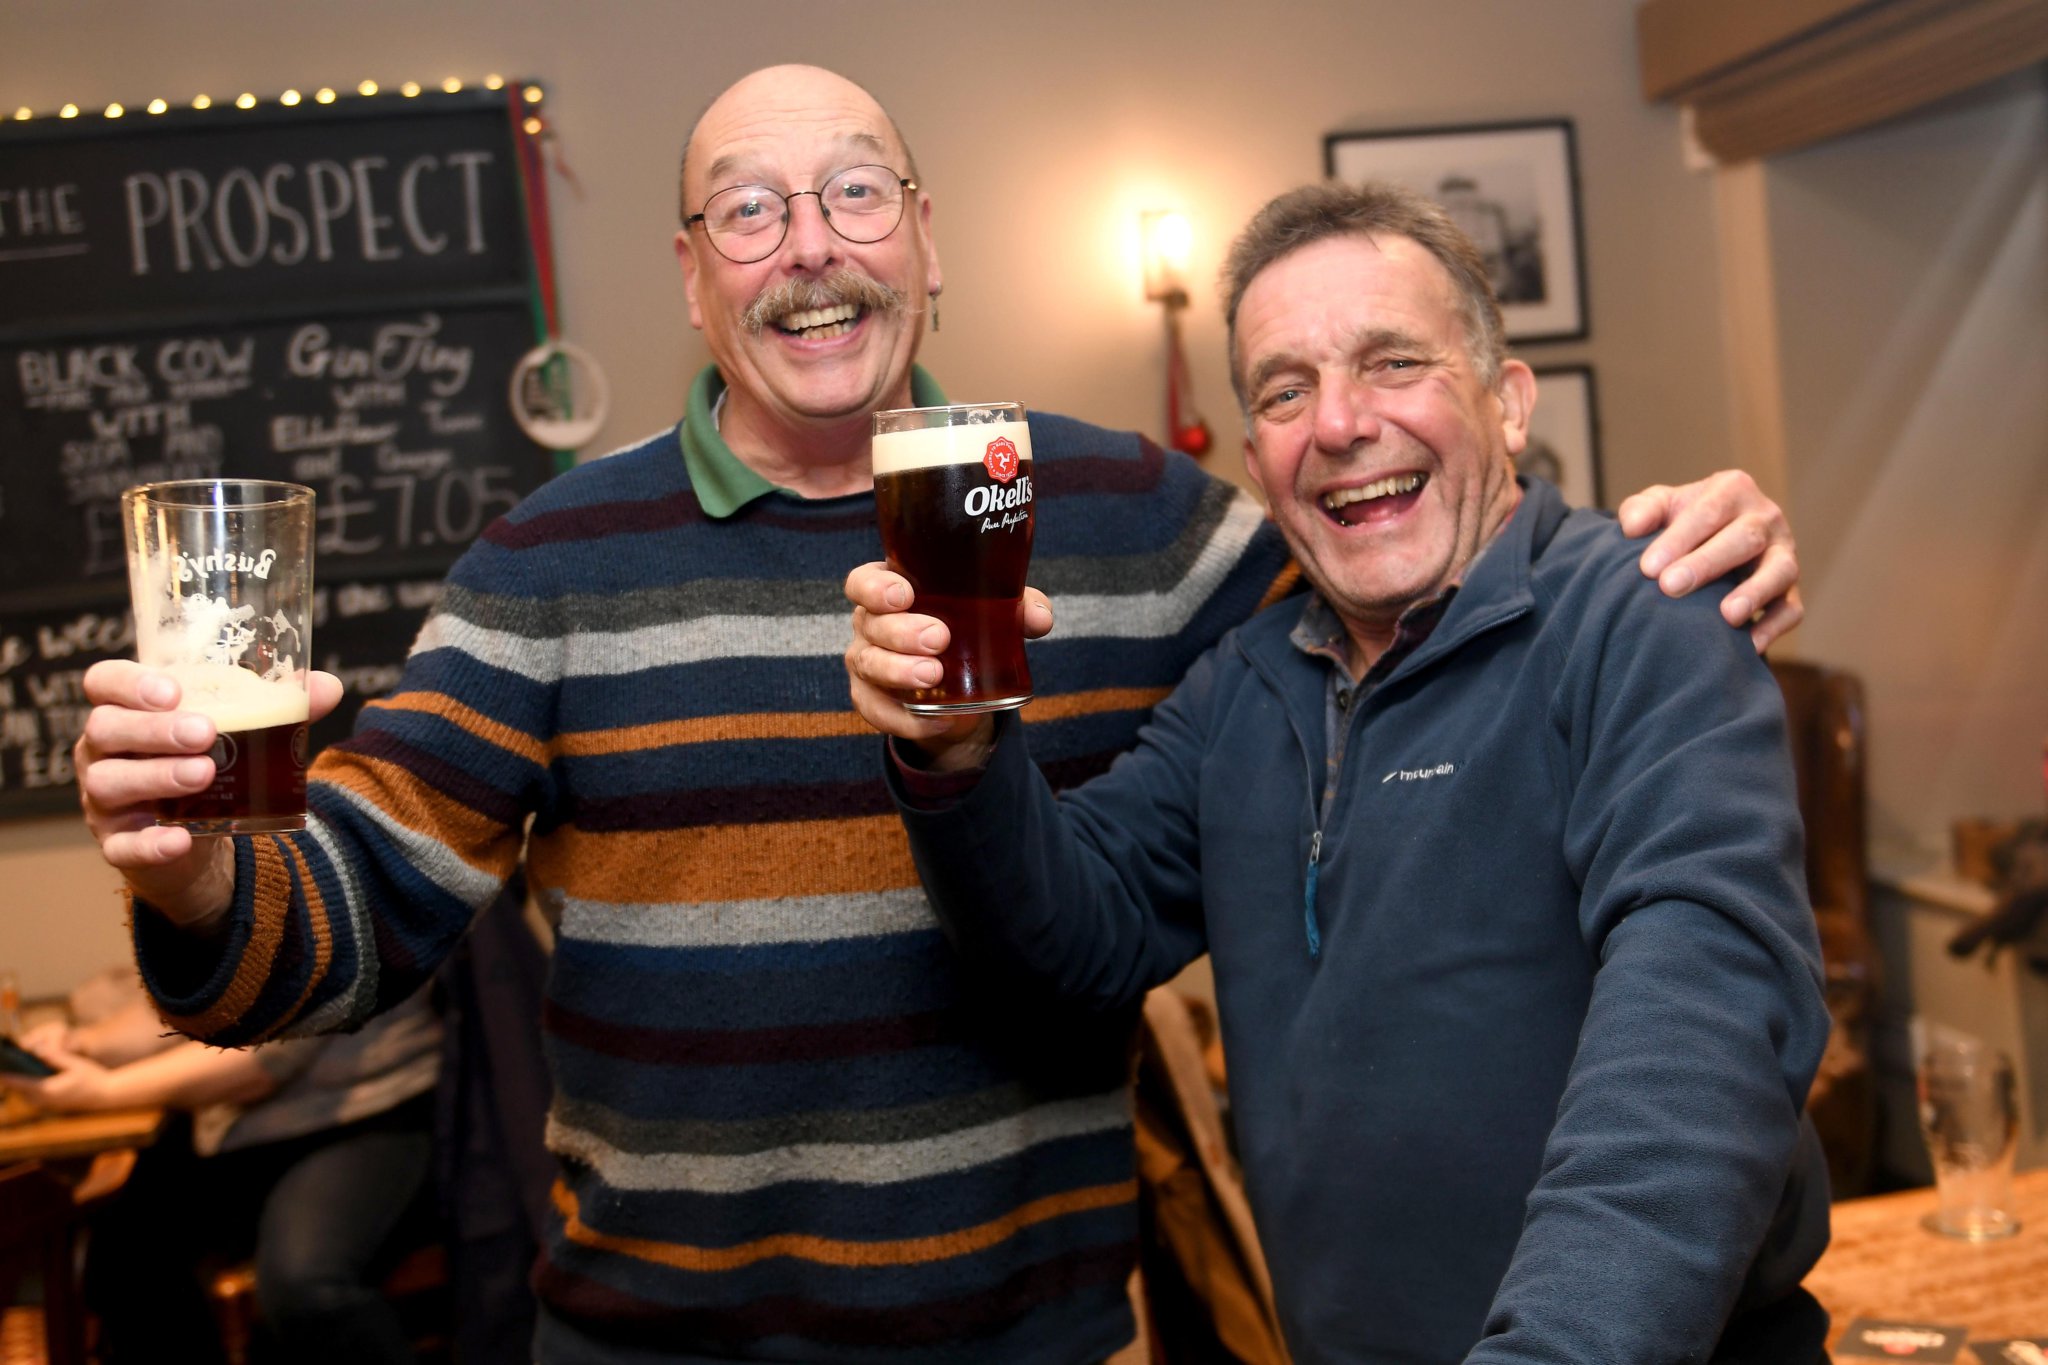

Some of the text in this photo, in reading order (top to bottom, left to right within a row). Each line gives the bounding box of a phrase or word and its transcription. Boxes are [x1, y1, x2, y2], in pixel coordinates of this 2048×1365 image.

[125, 151, 494, 275] PROSPECT
[18, 345, 147, 396] BLACK
[157, 338, 255, 382] COW
[964, 476, 1033, 517] Okell's
